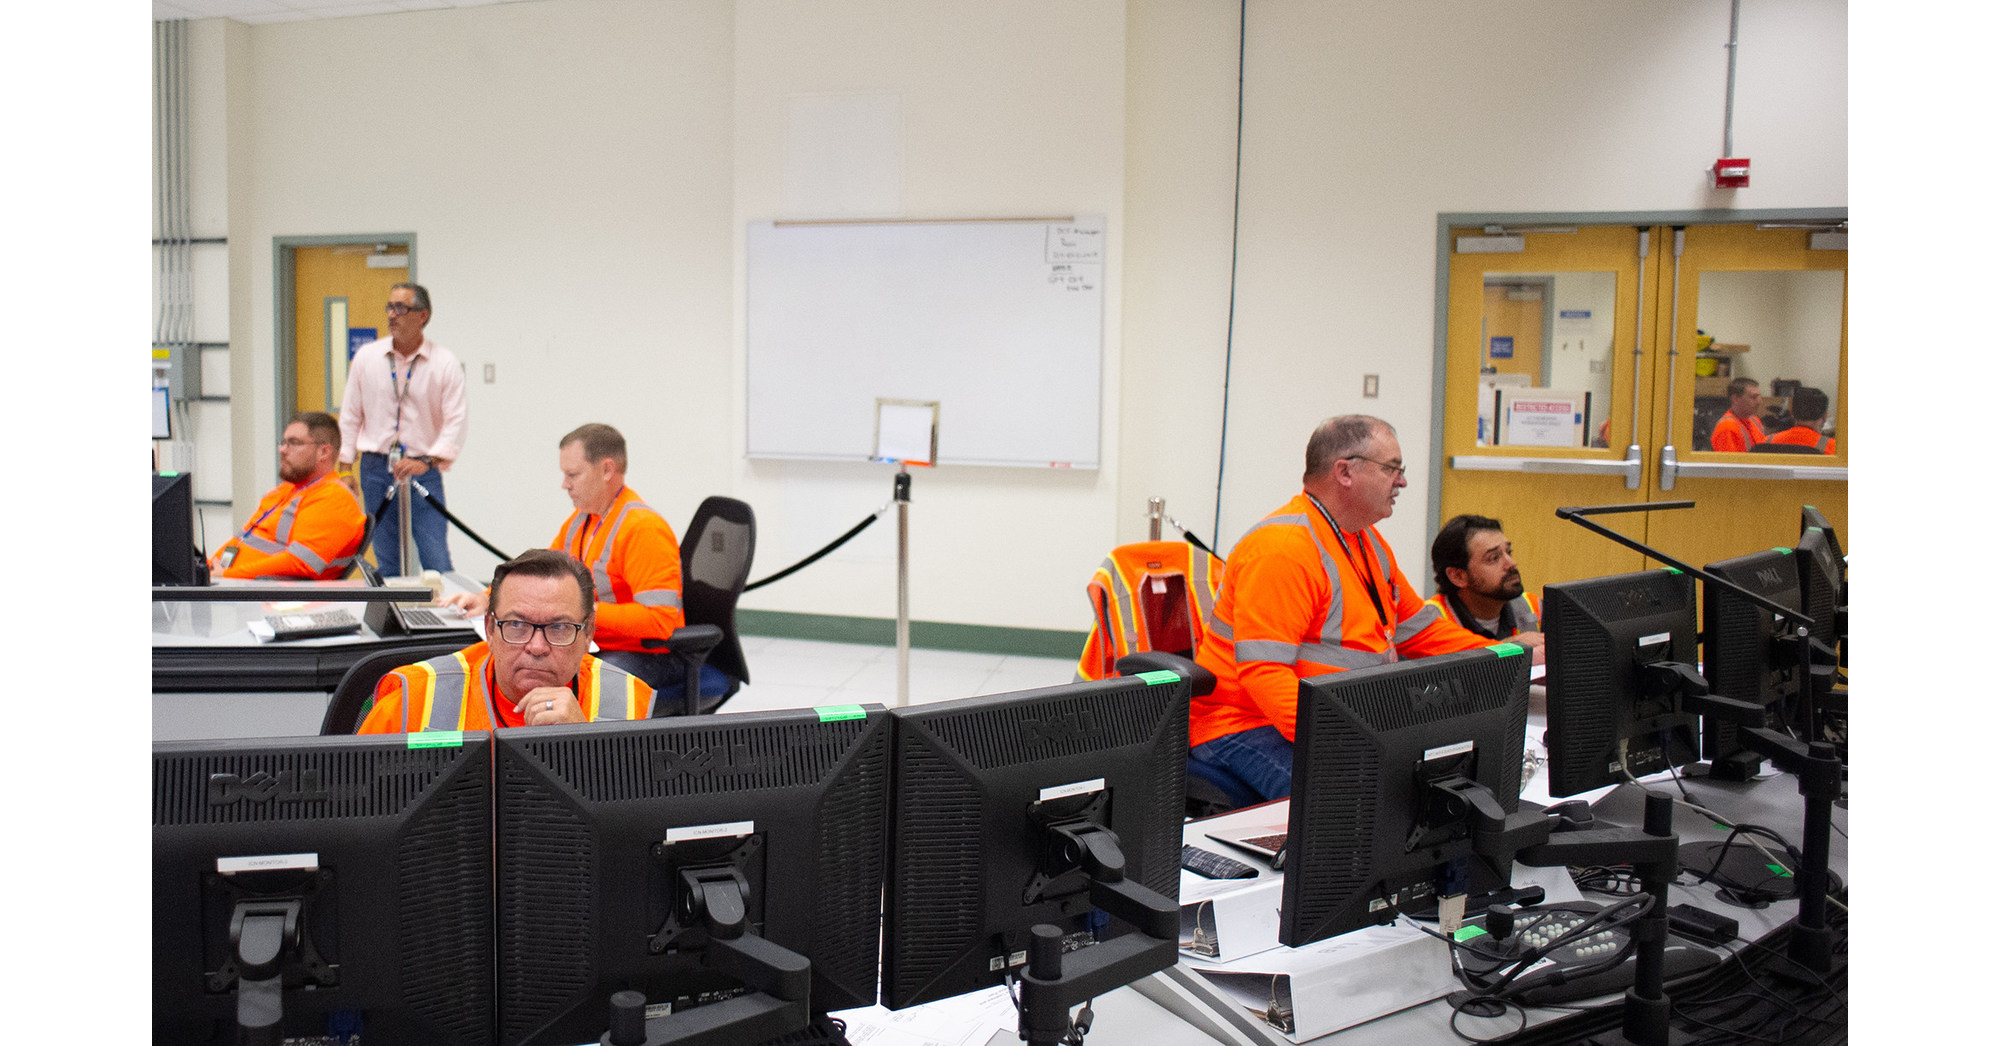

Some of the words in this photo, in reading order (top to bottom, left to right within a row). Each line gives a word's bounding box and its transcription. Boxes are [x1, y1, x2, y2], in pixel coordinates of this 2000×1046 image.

[1407, 679, 1469, 713] DELL
[1020, 711, 1100, 748] DELL
[652, 744, 756, 782] DELL
[210, 770, 328, 806] DELL
